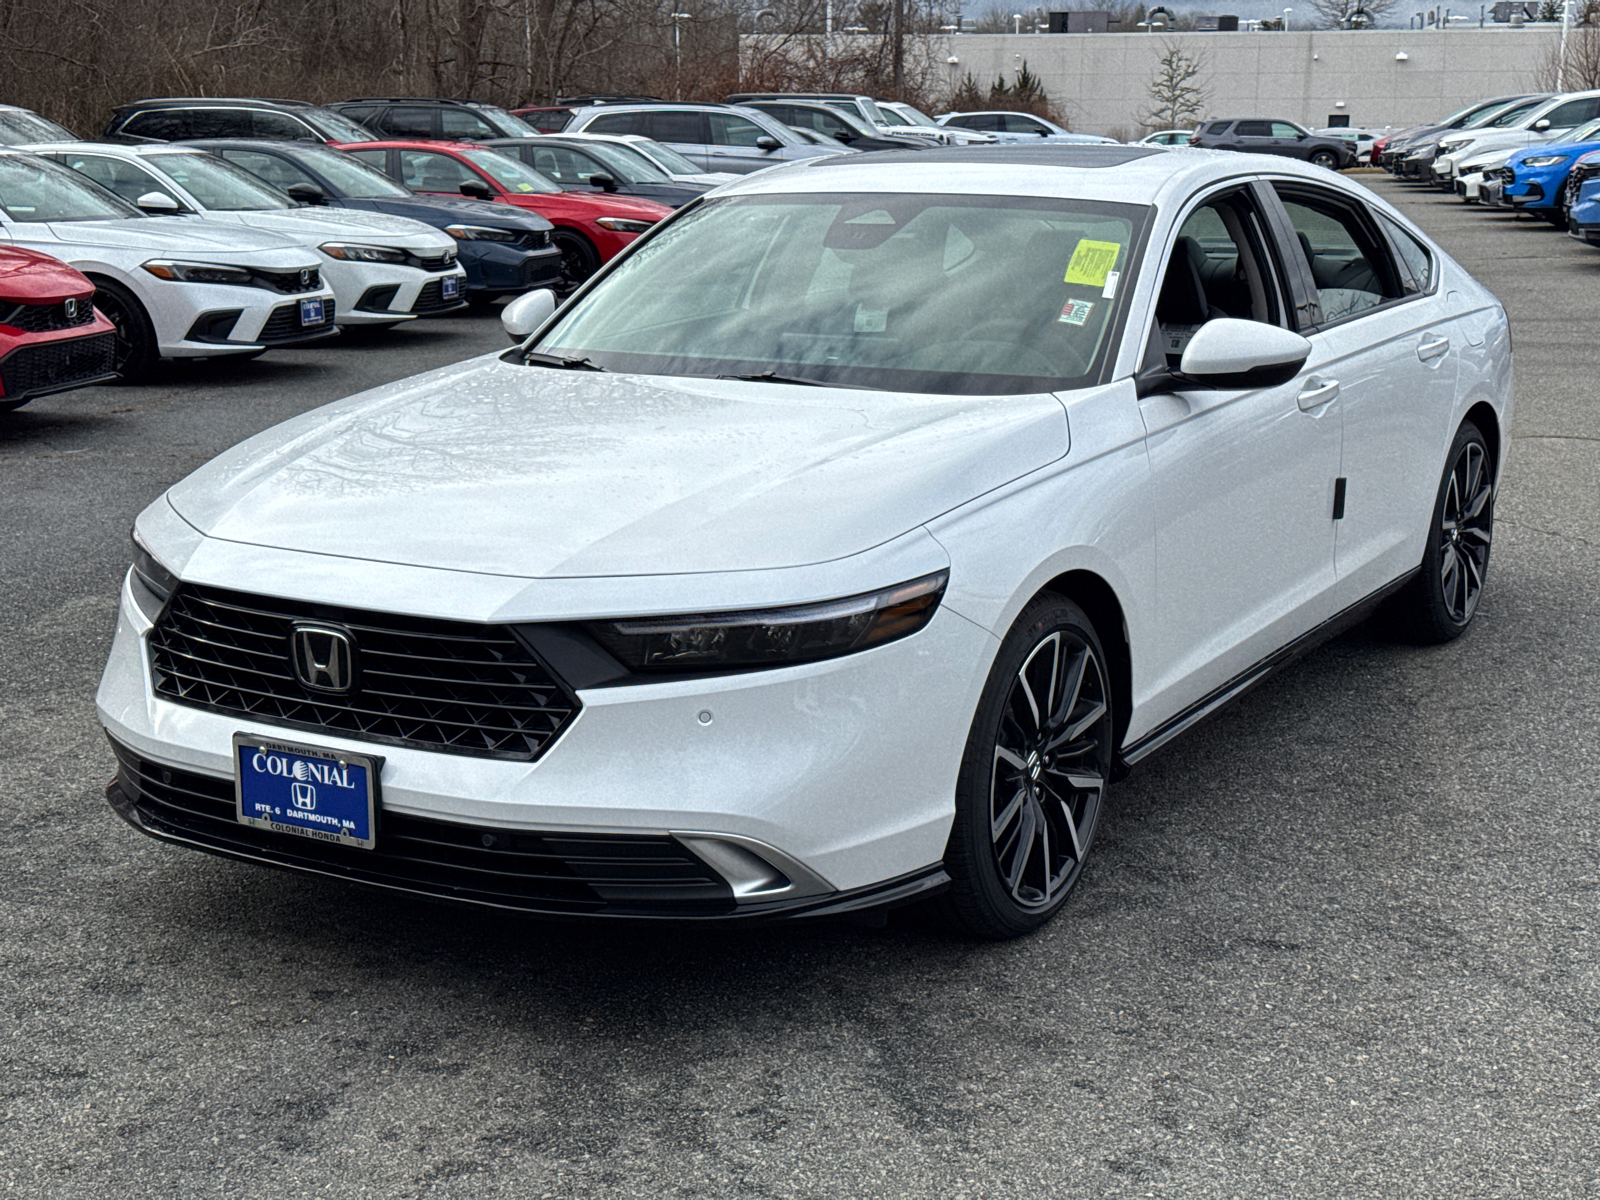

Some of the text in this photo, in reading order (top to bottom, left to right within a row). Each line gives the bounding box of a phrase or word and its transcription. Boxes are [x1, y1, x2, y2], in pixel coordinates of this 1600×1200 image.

[322, 752, 337, 760] MA
[252, 753, 355, 789] COLONIAL
[255, 803, 356, 830] RTE. 6 DARTMOUTH, MA
[270, 822, 341, 843] COLONIAL HONDA
